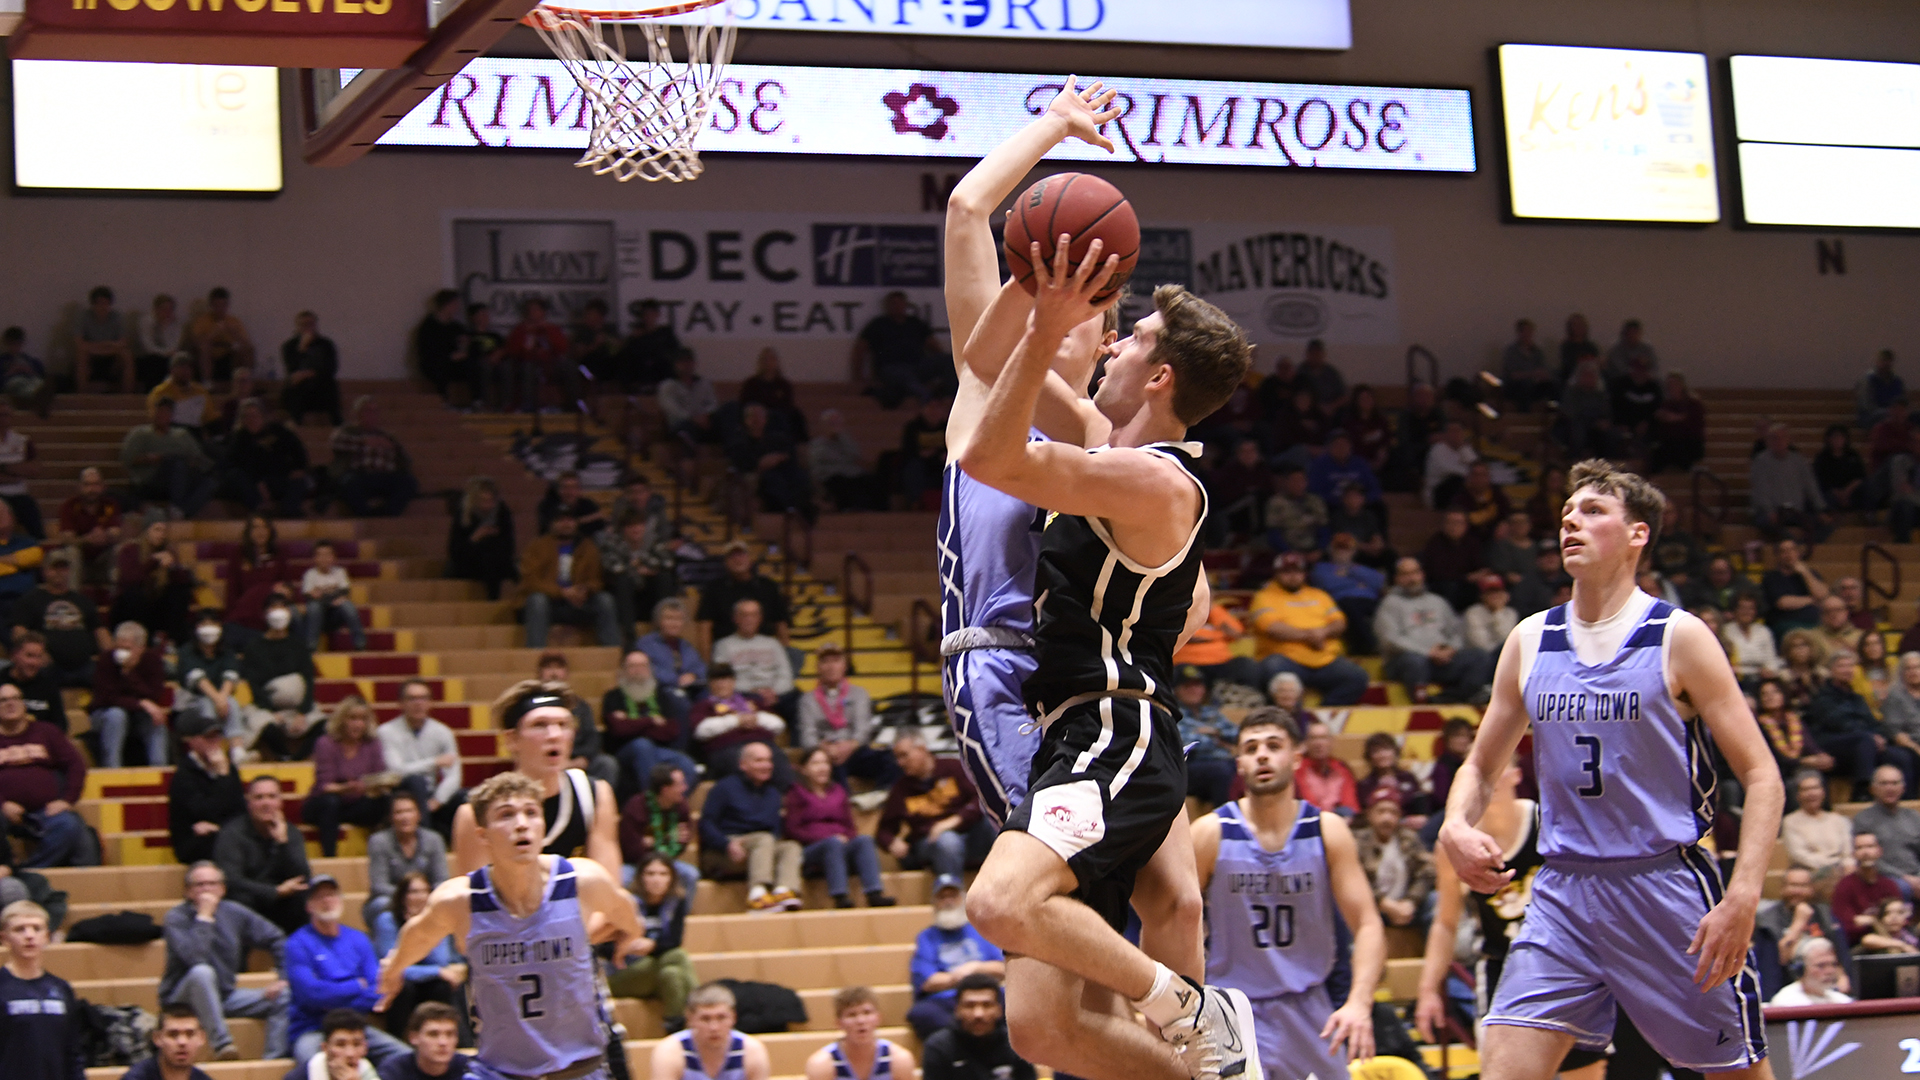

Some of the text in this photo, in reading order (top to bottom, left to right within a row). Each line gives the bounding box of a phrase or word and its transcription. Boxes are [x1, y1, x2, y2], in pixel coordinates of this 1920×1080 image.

[428, 74, 786, 147] RIMROSE
[487, 229, 608, 283] LAMONT
[650, 229, 798, 283] DEC
[1196, 231, 1388, 299] MAVERICKS
[1816, 239, 1846, 274] N
[773, 302, 862, 332] EAT
[1537, 690, 1640, 722] UPPER IOWA
[1574, 734, 1604, 798] 3
[1229, 871, 1313, 895] UPPER IOWA
[1251, 904, 1295, 948] 20
[482, 936, 573, 967] UPPER IOWA
[519, 973, 545, 1019] 2
